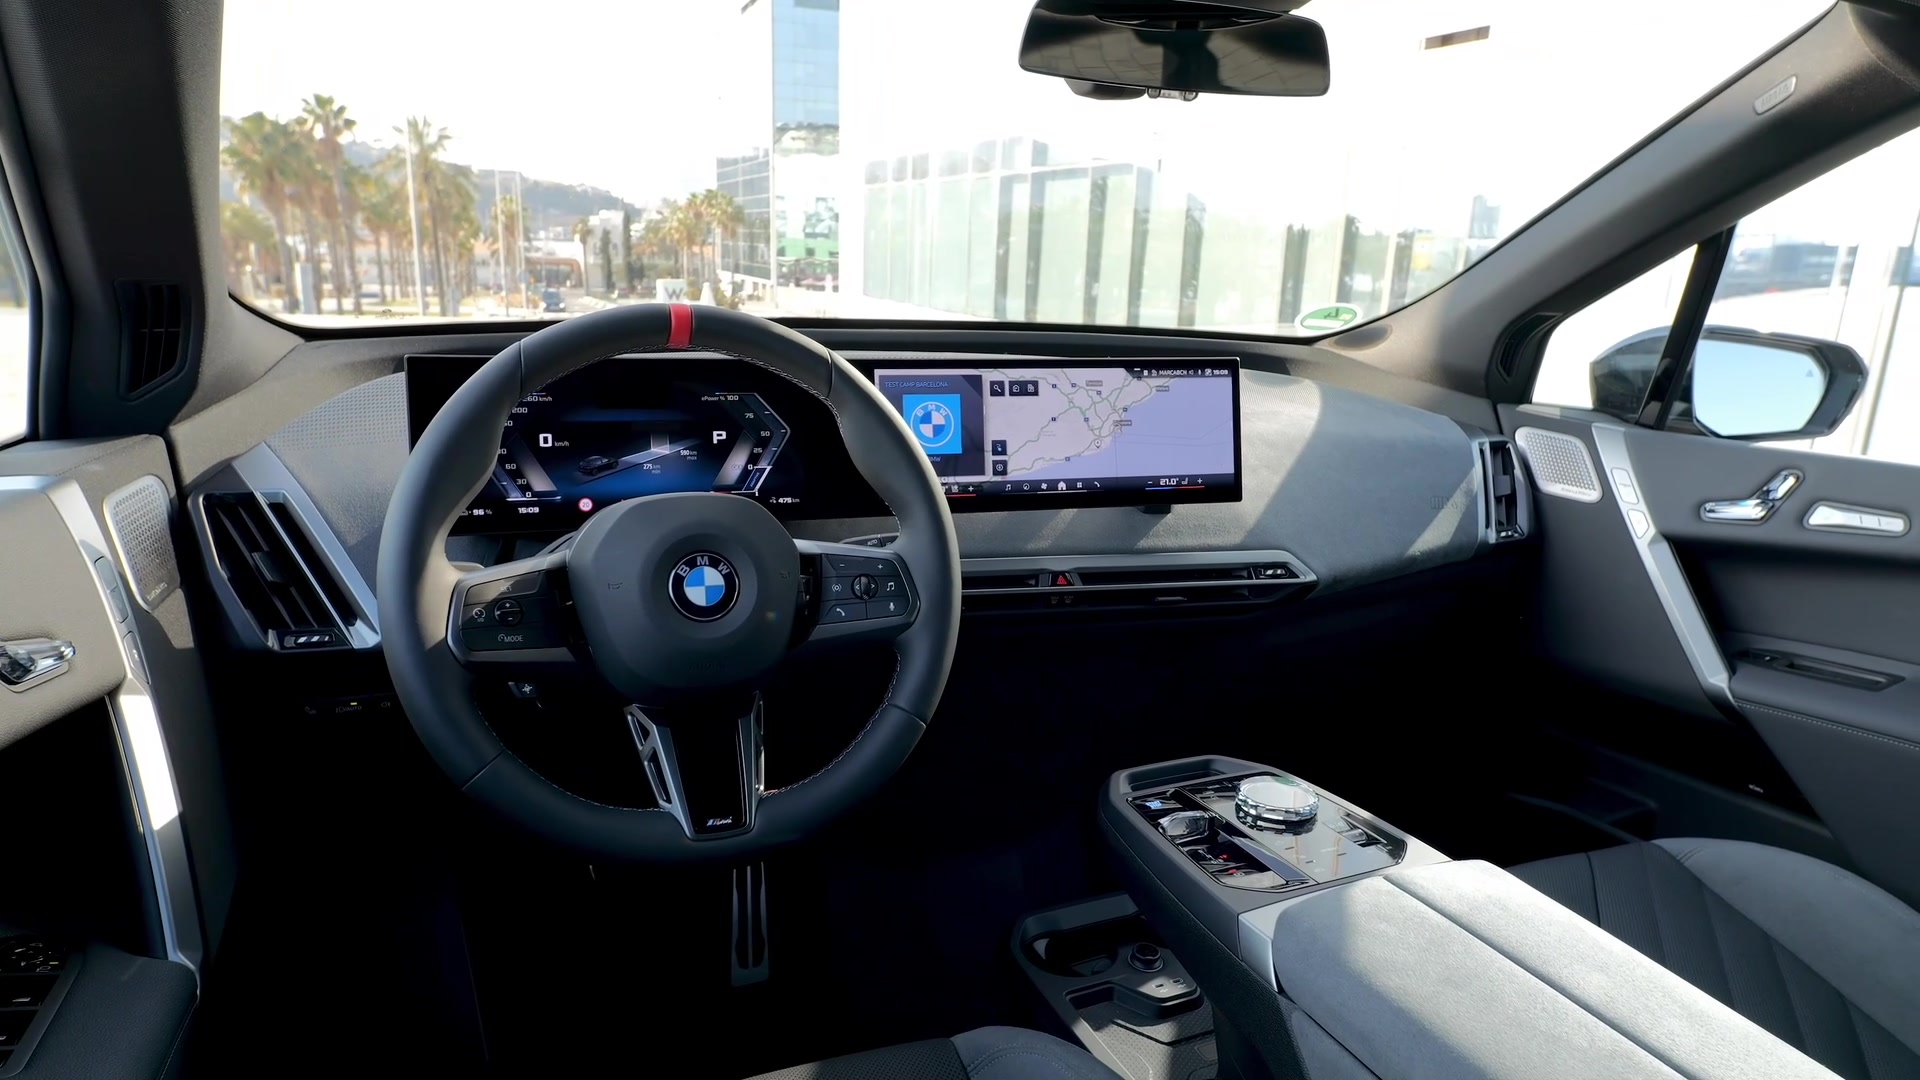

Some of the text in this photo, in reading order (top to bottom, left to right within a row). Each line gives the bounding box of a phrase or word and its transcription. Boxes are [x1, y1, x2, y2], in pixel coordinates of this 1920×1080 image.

[916, 404, 948, 417] BMW
[539, 433, 552, 447] 0
[713, 431, 726, 444] P
[518, 506, 539, 514] 15:09
[676, 555, 731, 578] BMW
[504, 634, 524, 643] MODE
